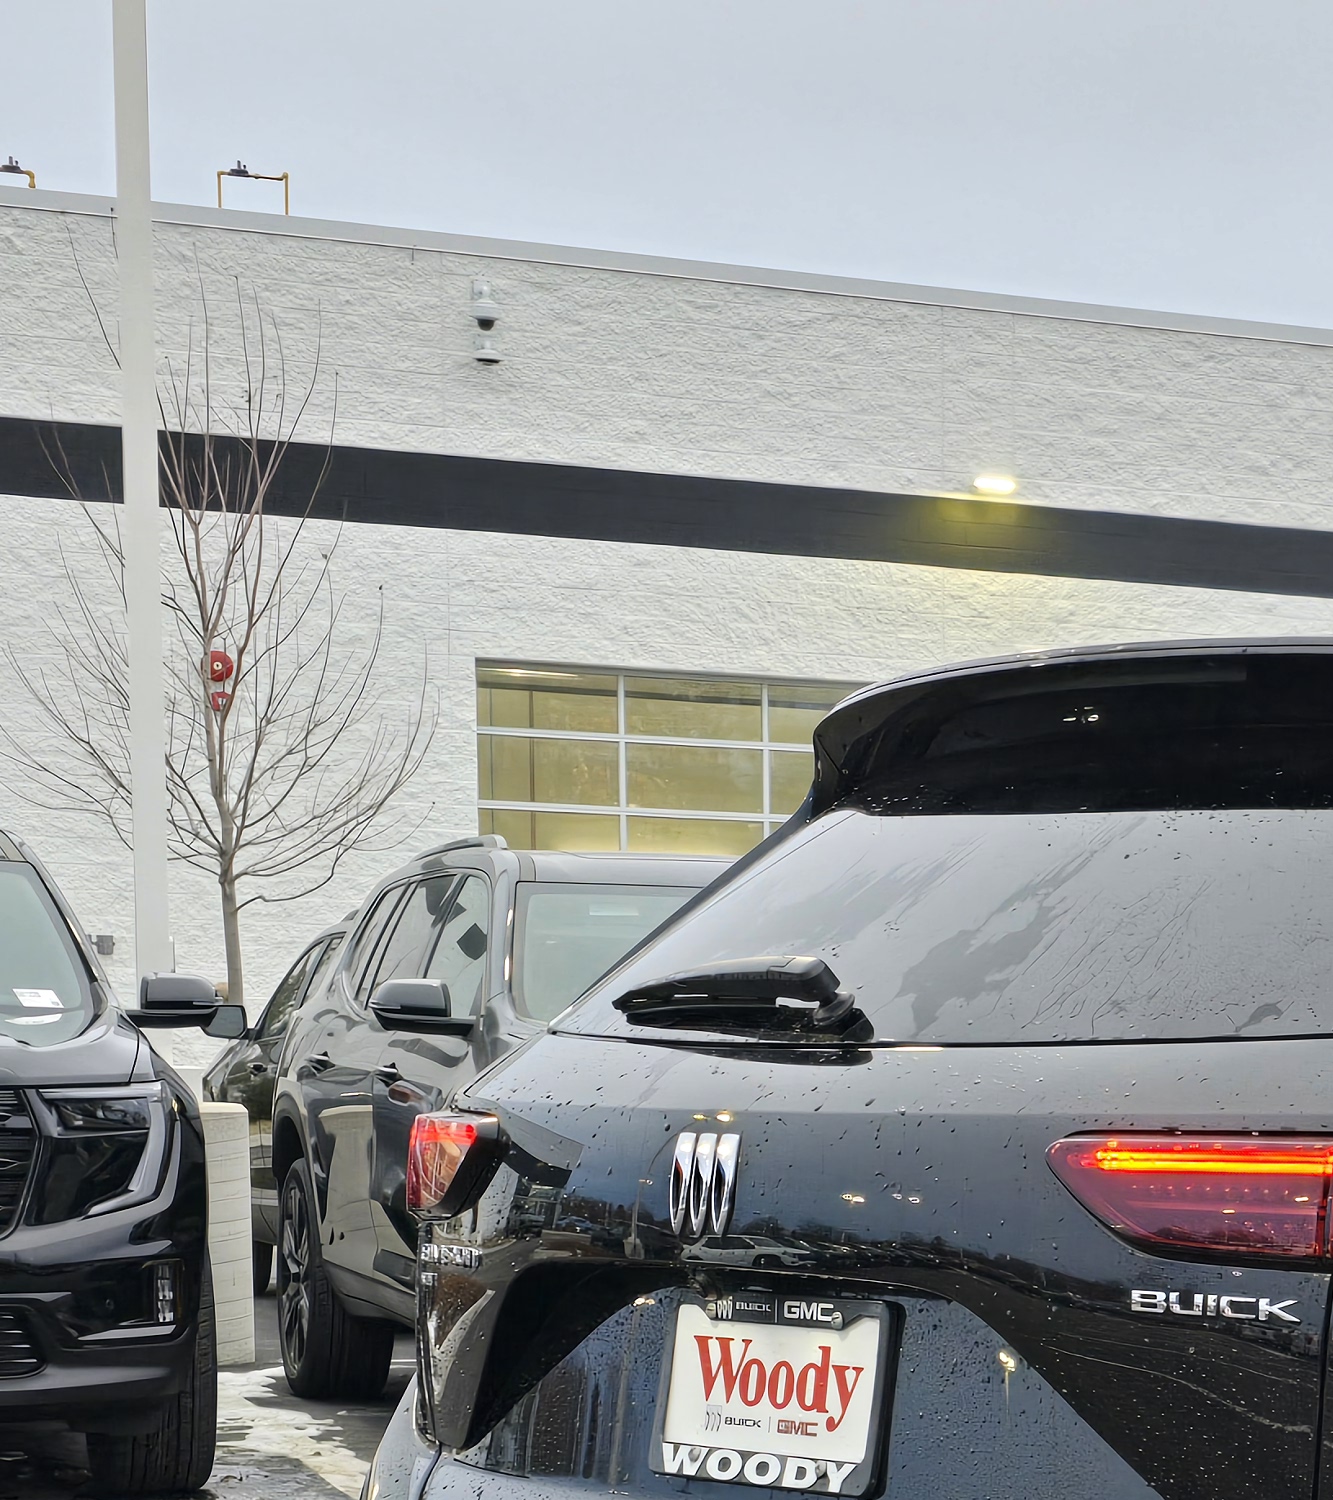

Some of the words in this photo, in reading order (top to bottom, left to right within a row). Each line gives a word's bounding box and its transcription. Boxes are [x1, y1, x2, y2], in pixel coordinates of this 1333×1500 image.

[783, 1300, 834, 1322] GMC
[1131, 1289, 1301, 1323] BUICK
[693, 1335, 864, 1433] Woody
[724, 1416, 761, 1428] BUICK
[777, 1419, 818, 1437] GMC
[662, 1442, 857, 1493] WOODY
